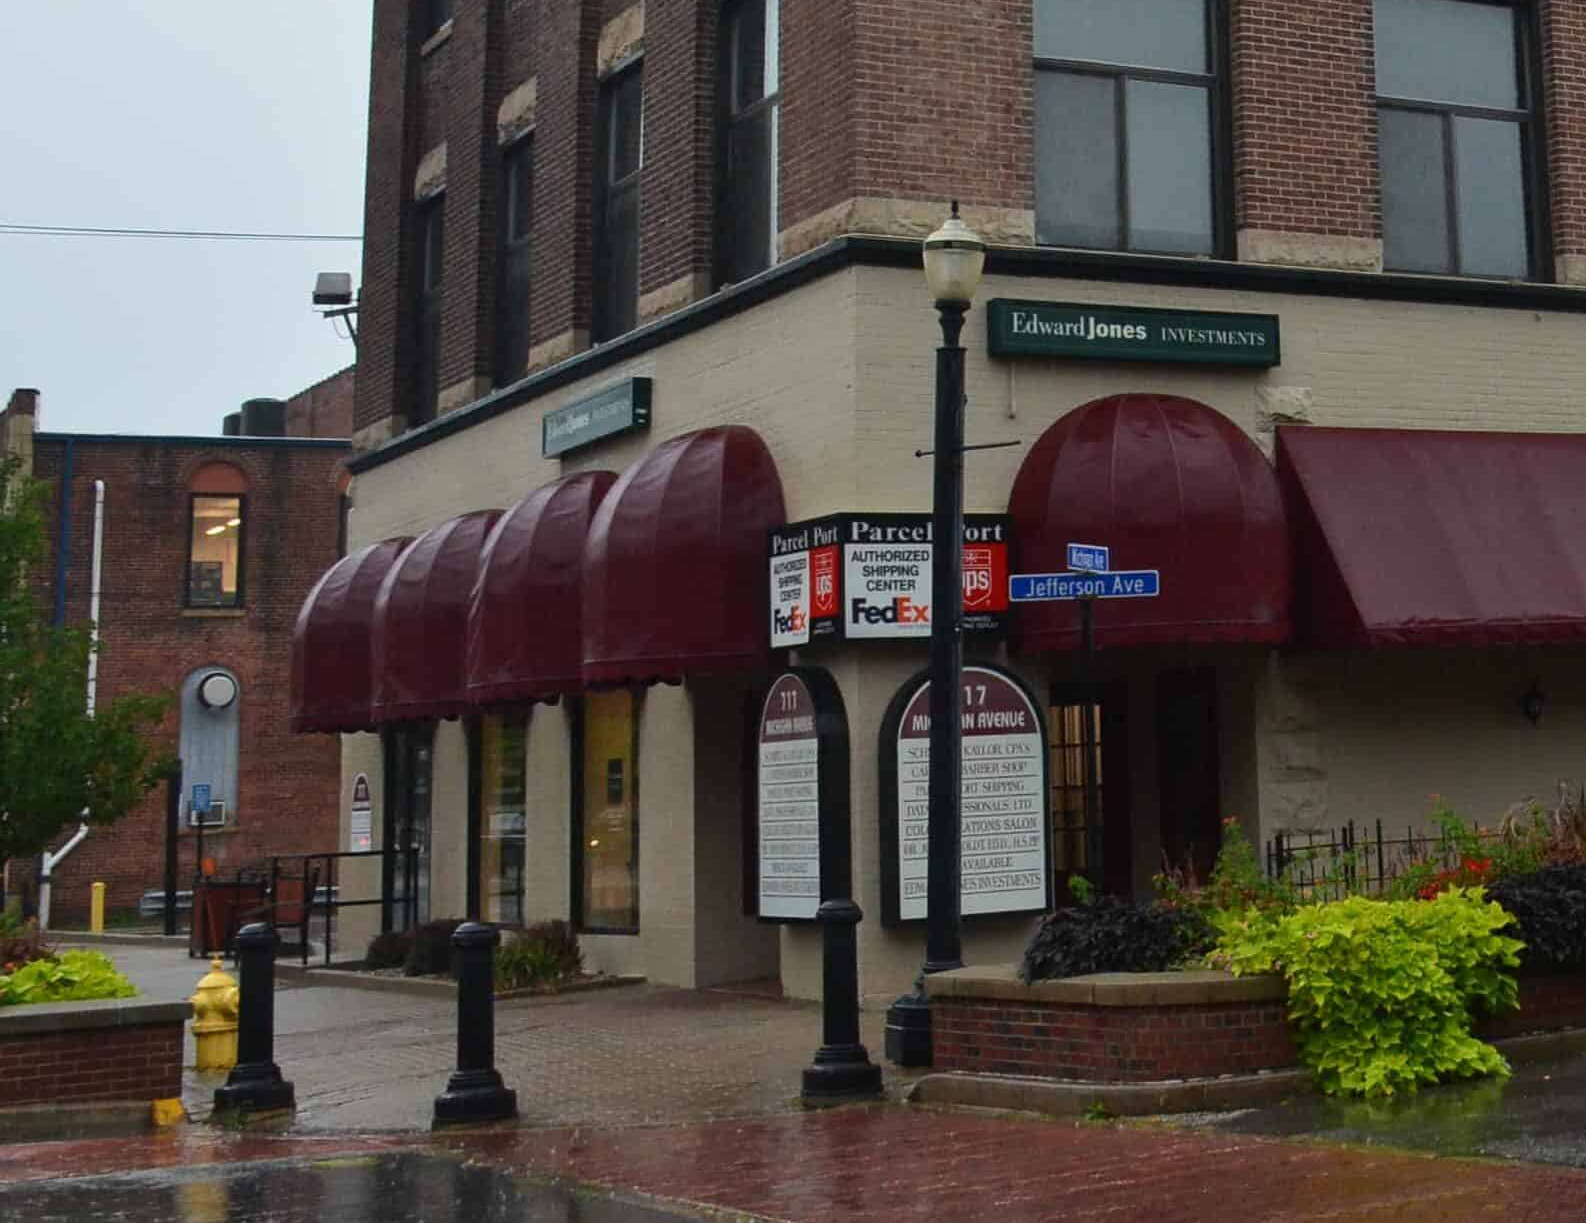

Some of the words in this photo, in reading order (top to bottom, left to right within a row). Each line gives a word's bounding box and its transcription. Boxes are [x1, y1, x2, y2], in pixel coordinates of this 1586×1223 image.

[1012, 311, 1087, 337] Edward
[1086, 316, 1147, 340] Jones
[1160, 327, 1266, 346] INVESTMENTS
[773, 530, 809, 555] Parcel
[813, 526, 838, 547] Port
[851, 521, 933, 542] Parcel
[961, 524, 1003, 542] ort
[851, 550, 930, 562] AUTHORIZED
[862, 564, 920, 577] SHIPPING
[866, 579, 916, 592] CENTER
[962, 569, 989, 597] ps
[1026, 577, 1105, 597] Jefferson
[1112, 575, 1145, 594] Ave
[774, 603, 807, 635] FedEx
[851, 596, 930, 625] FedEx
[963, 685, 987, 706] 17
[978, 711, 1025, 728] AVENUE
